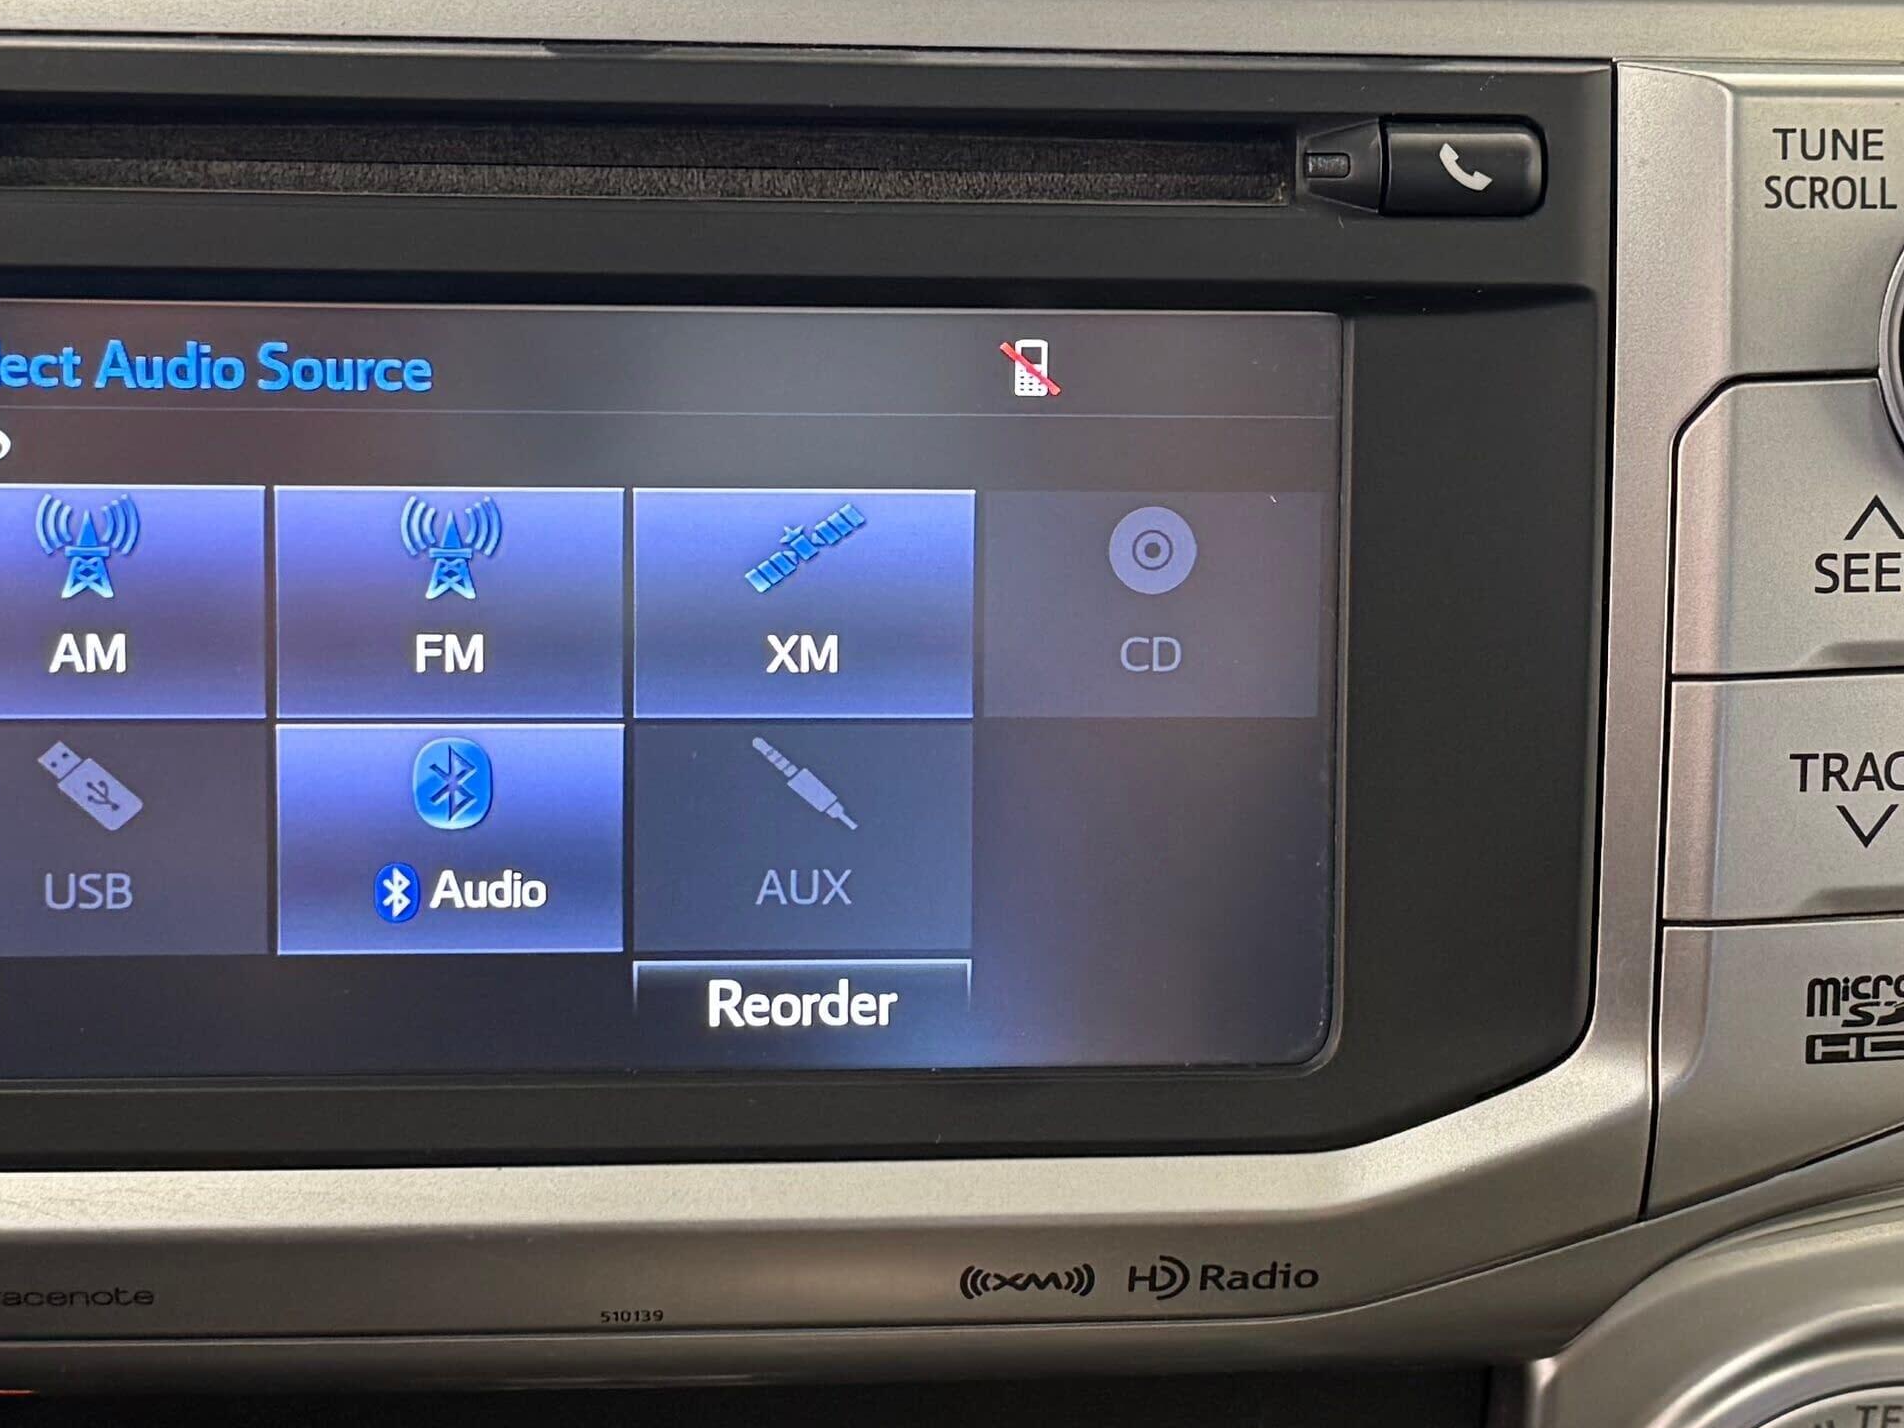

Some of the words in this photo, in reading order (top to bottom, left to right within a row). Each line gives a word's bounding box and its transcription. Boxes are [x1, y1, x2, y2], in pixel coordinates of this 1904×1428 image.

[1772, 127, 1886, 162] TUNE
[1763, 174, 1899, 211] SCROLL
[93, 338, 246, 392] Audio
[257, 341, 434, 393] Source
[48, 632, 128, 674] AM
[414, 632, 485, 674] FM
[765, 632, 840, 675] XM
[1119, 635, 1183, 674] CD
[44, 871, 134, 912] USB
[429, 869, 548, 910] Audio
[755, 868, 853, 907] AUX
[706, 977, 899, 1029] Reorder
[1199, 1260, 1320, 1292] Radio
[599, 1308, 665, 1324] 510139
